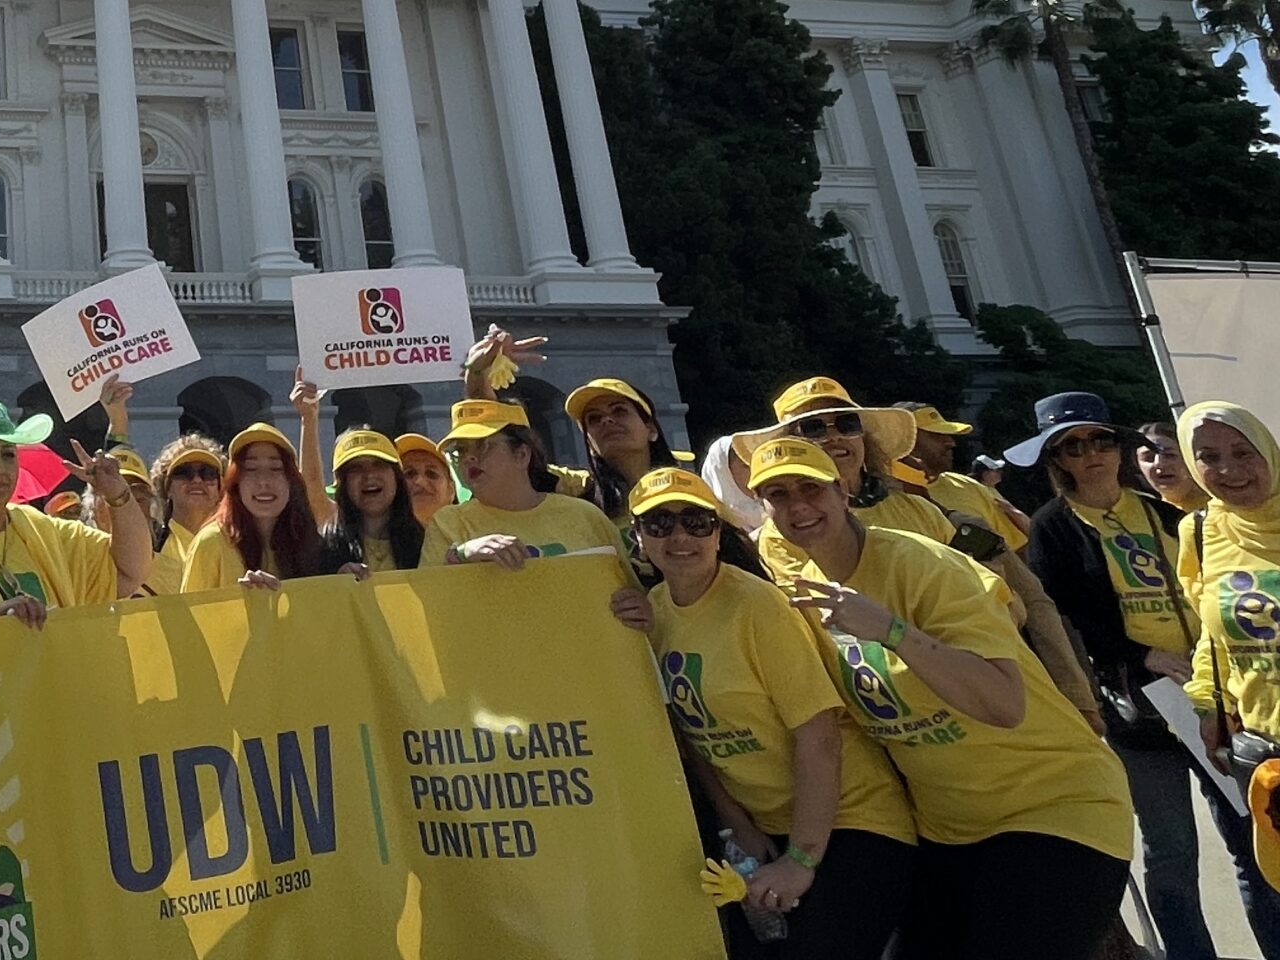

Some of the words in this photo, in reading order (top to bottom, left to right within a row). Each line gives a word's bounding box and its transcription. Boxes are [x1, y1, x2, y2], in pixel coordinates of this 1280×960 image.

[67, 344, 122, 378] CALIFORNIA
[122, 333, 150, 349] RUNS
[150, 327, 167, 340] ON
[324, 338, 393, 353] CALIFORNIA
[396, 336, 429, 347] RUNS
[431, 335, 450, 345] ON
[402, 728, 496, 766] CHILD
[504, 720, 594, 761] CARE
[98, 725, 336, 893] UDW
[410, 767, 594, 812] PROVIDERS
[418, 820, 538, 859] UNITED
[159, 890, 224, 920] AFSCME
[226, 882, 273, 908] LOCAL
[275, 868, 312, 896] 3930
